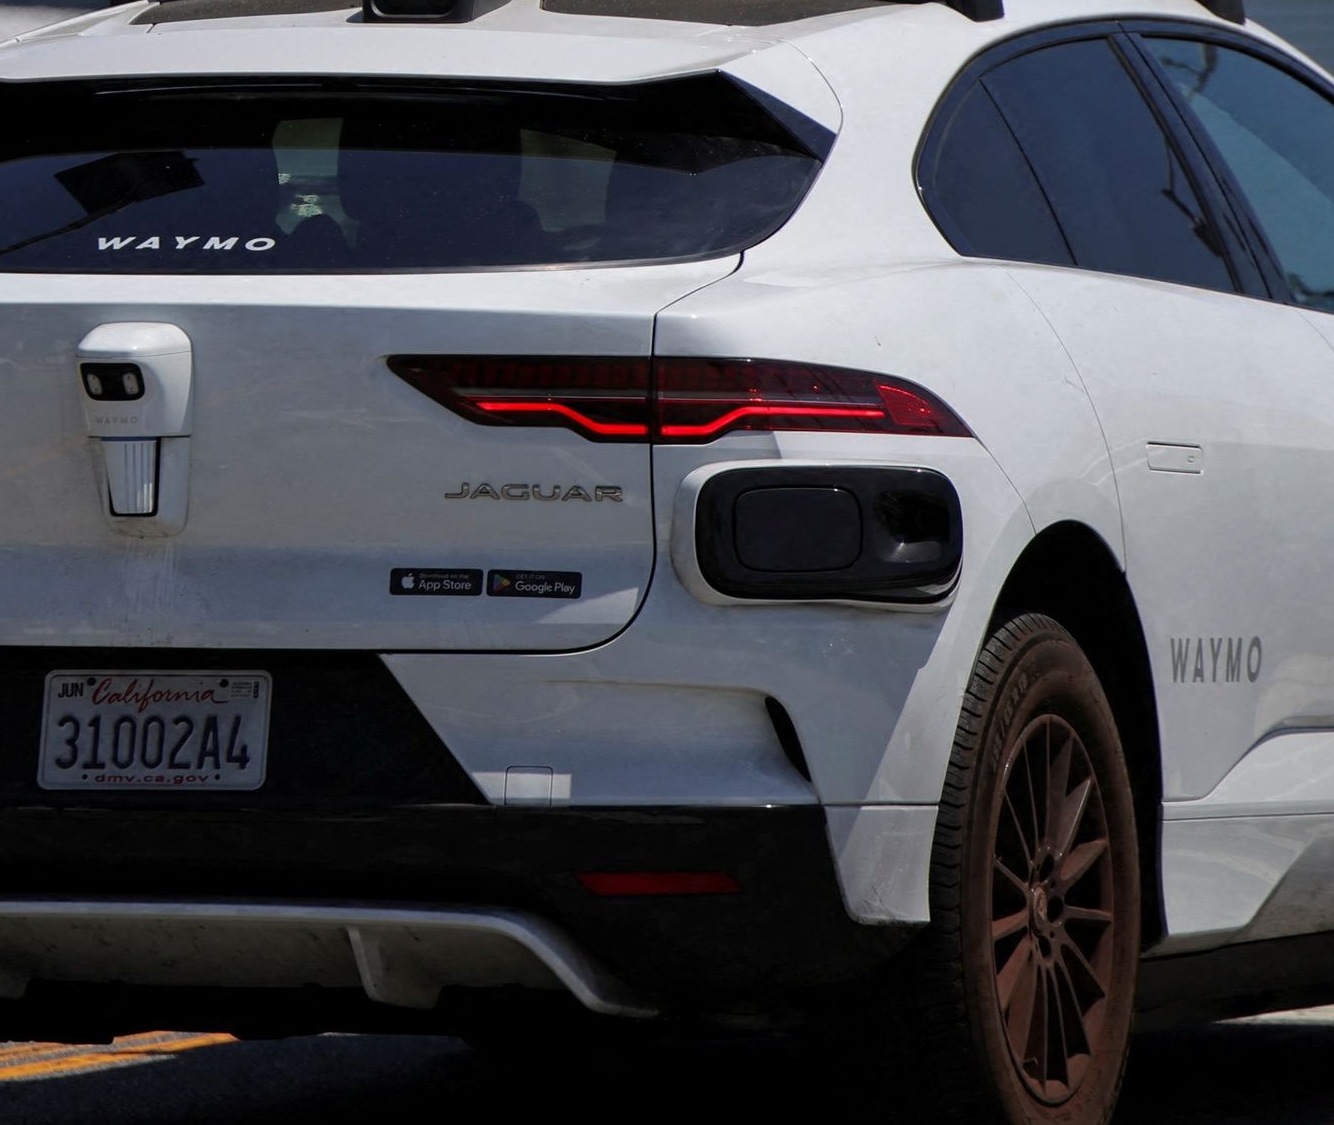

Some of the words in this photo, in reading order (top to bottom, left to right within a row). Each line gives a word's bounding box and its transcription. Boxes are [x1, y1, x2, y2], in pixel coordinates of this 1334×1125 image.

[98, 236, 276, 251] WAYMO
[444, 482, 624, 503] JAGUAR
[418, 579, 441, 591] App
[442, 579, 472, 590] Store
[515, 580, 553, 594] Google
[554, 581, 576, 595] Play
[1170, 636, 1262, 683] WAYMO
[57, 682, 84, 698] JUN
[91, 678, 229, 713] California
[55, 714, 250, 770] 31002A4
[95, 774, 209, 784] dmv.ca.gov
